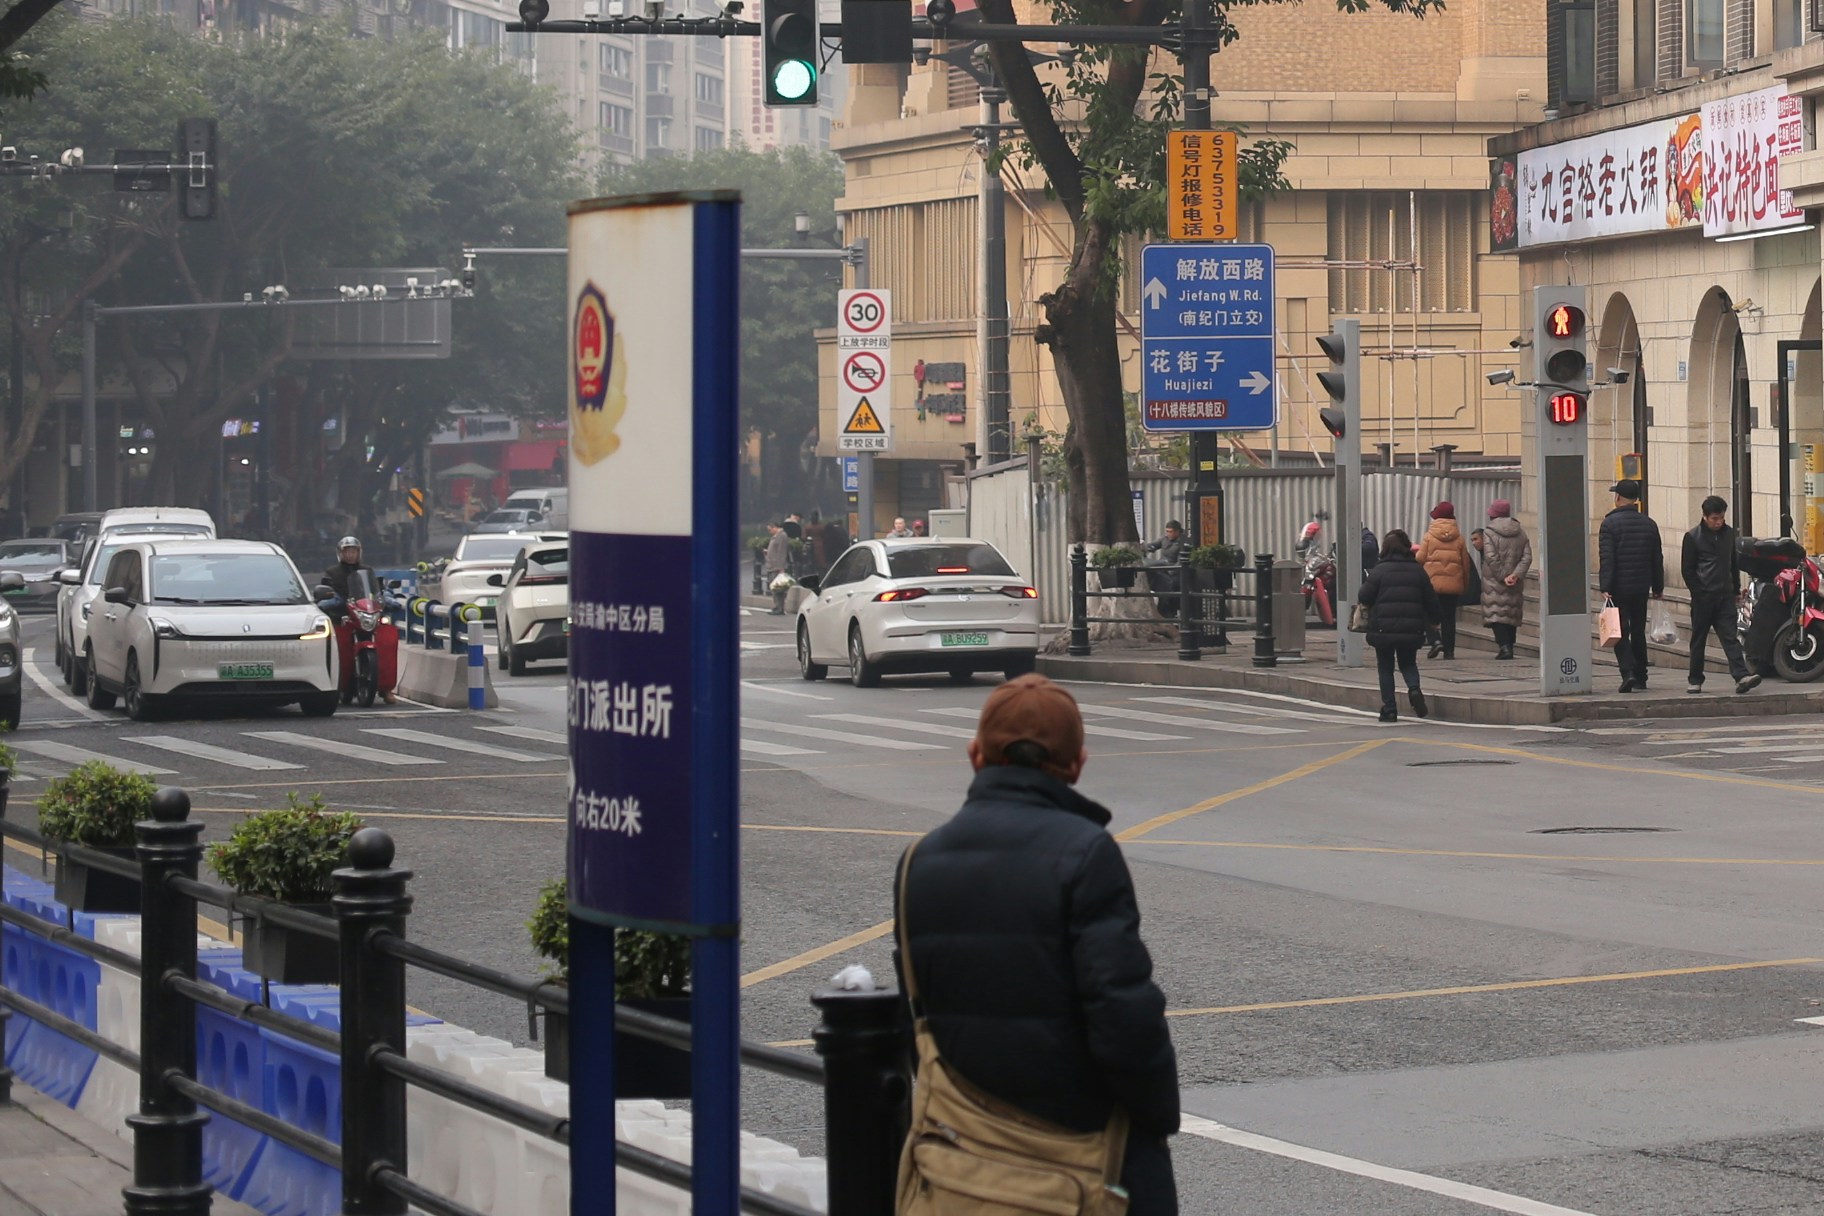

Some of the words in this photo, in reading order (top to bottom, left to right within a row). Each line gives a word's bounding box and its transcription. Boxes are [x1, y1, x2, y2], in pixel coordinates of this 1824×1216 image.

[1181, 134, 1203, 236] 信号灯报修电话
[1212, 134, 1225, 236] 63753319
[1541, 146, 1659, 224] 九宫格老火锅
[1703, 127, 1778, 228] 洪记特色面
[1176, 258, 1265, 281] 解放西路
[1179, 289, 1226, 304] Jiefang
[1230, 290, 1241, 301] W.
[1244, 289, 1262, 301] Rd.
[851, 303, 879, 322] 30
[1179, 310, 1263, 326] (南纪门立交)
[840, 337, 888, 348] 上放学时段
[1150, 349, 1225, 373] 花街子
[1165, 378, 1213, 393] Huajiezi
[1149, 401, 1226, 419] (十八梯传统风貌区)
[1551, 396, 1576, 422] 10
[843, 437, 886, 449] 学校区域
[574, 601, 665, 634] 安局渝中区分局
[576, 787, 643, 837] 向右20米
